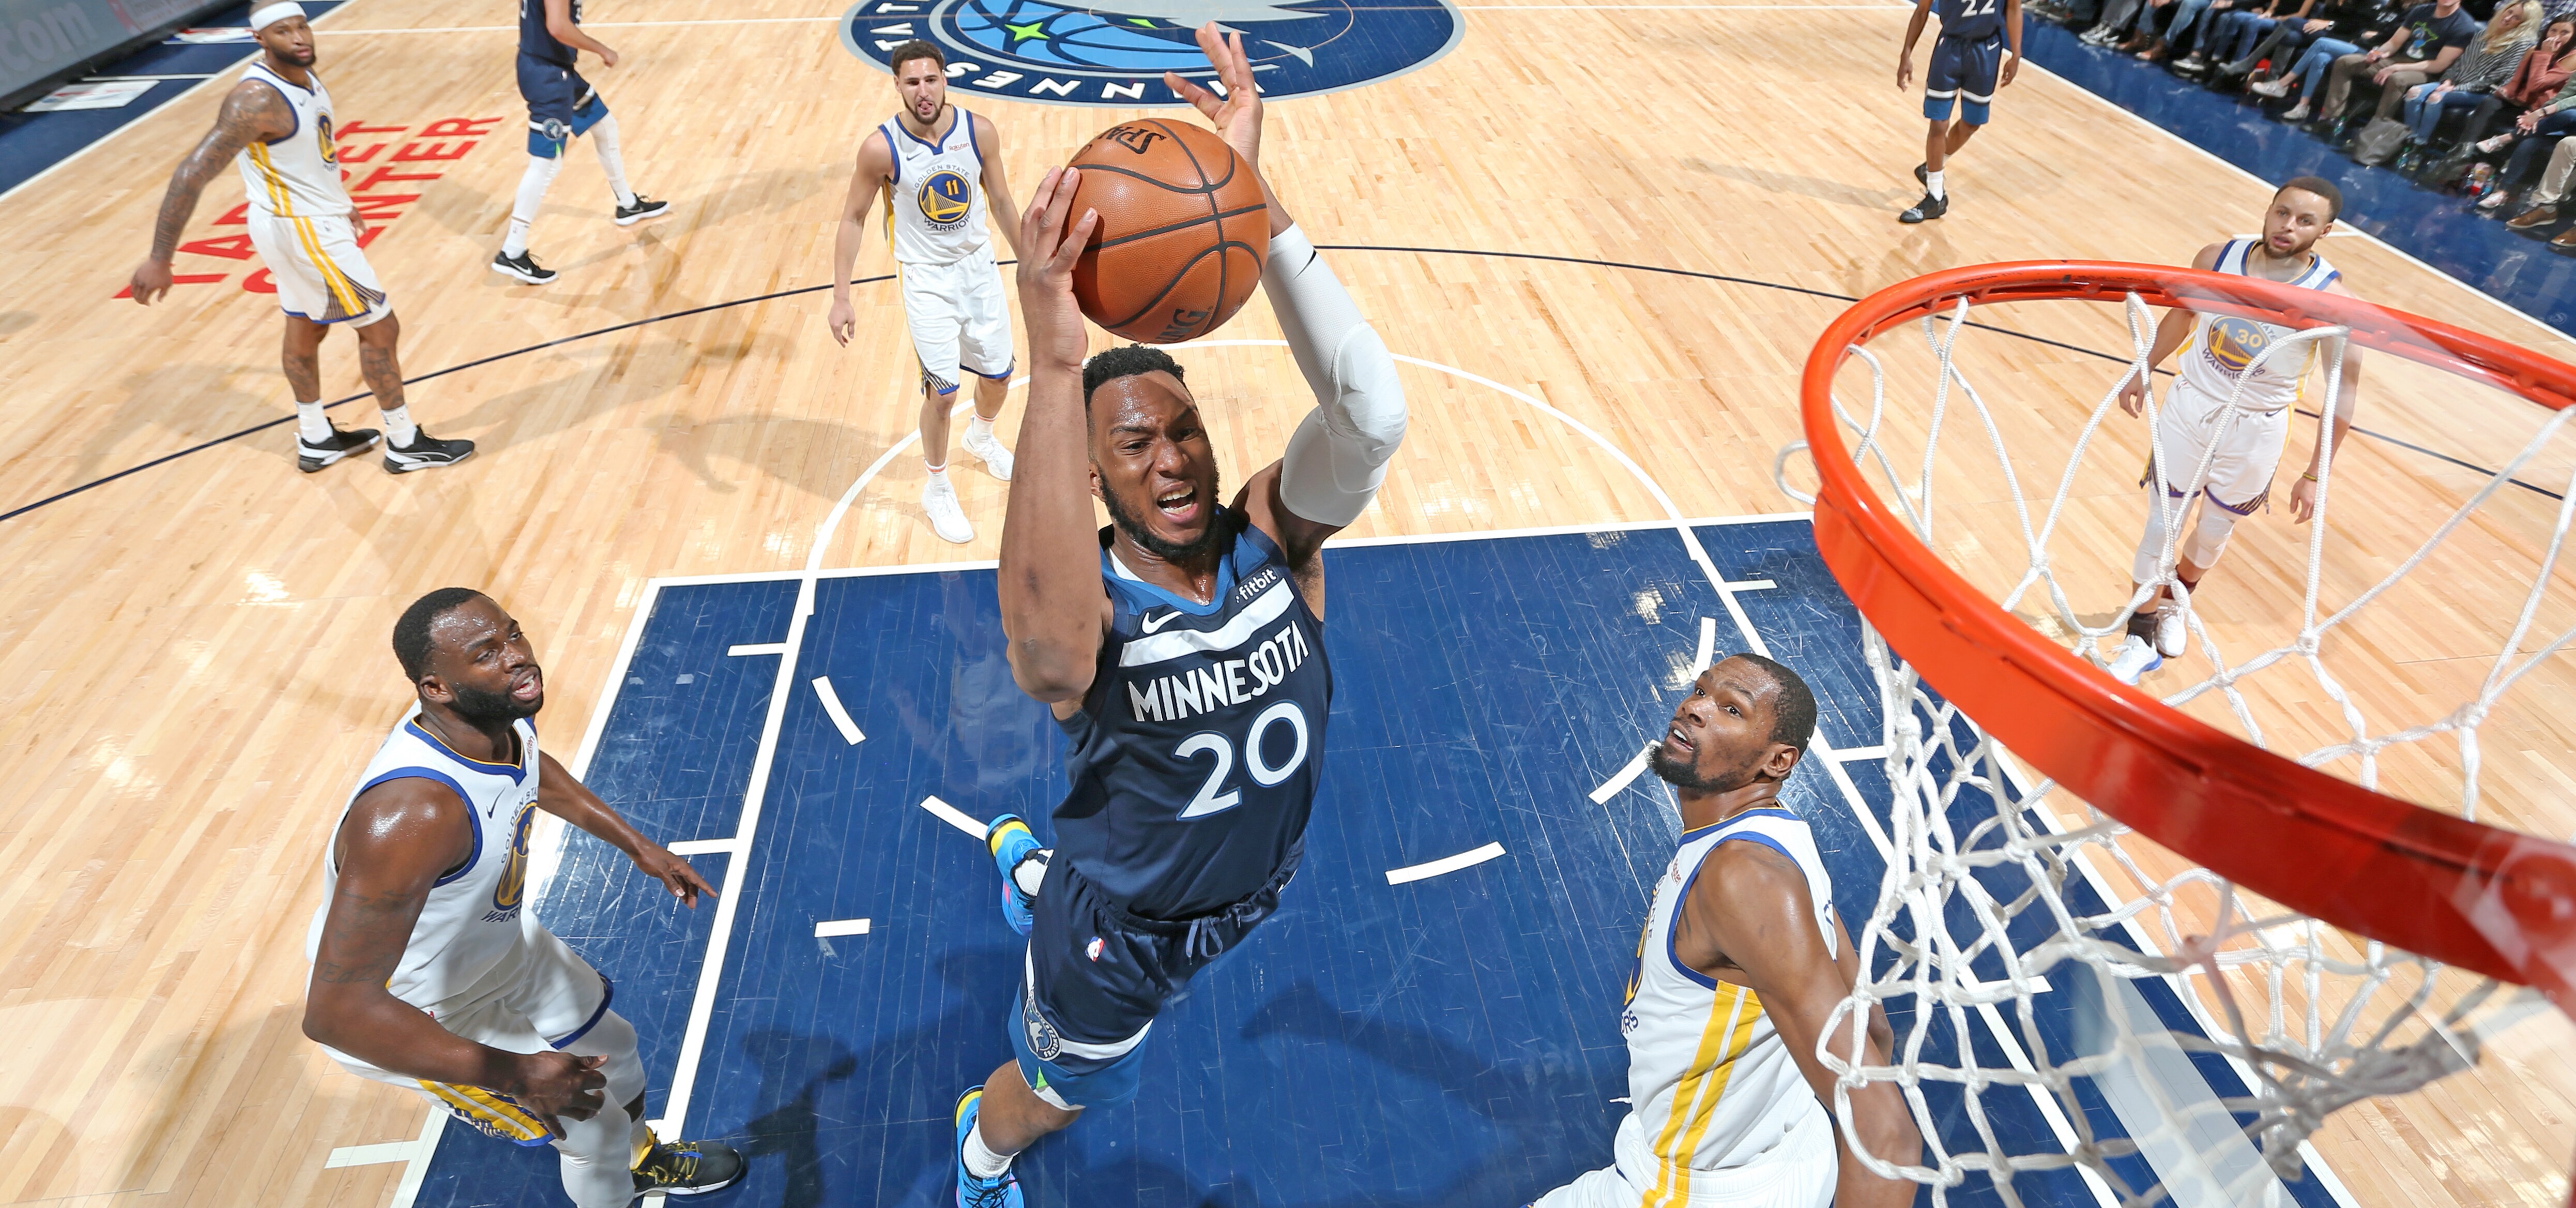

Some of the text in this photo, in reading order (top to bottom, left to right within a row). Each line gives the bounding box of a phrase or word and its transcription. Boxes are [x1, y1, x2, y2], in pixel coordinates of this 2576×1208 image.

[914, 164, 970, 189] GOLDEN STATE
[946, 179, 959, 196] 11
[2234, 329, 2263, 348] 30
[1239, 569, 1277, 600] fitbit
[1127, 620, 1309, 722] MINNESOTA
[1174, 699, 1309, 821] 20
[501, 799, 524, 864] GOLDEN
